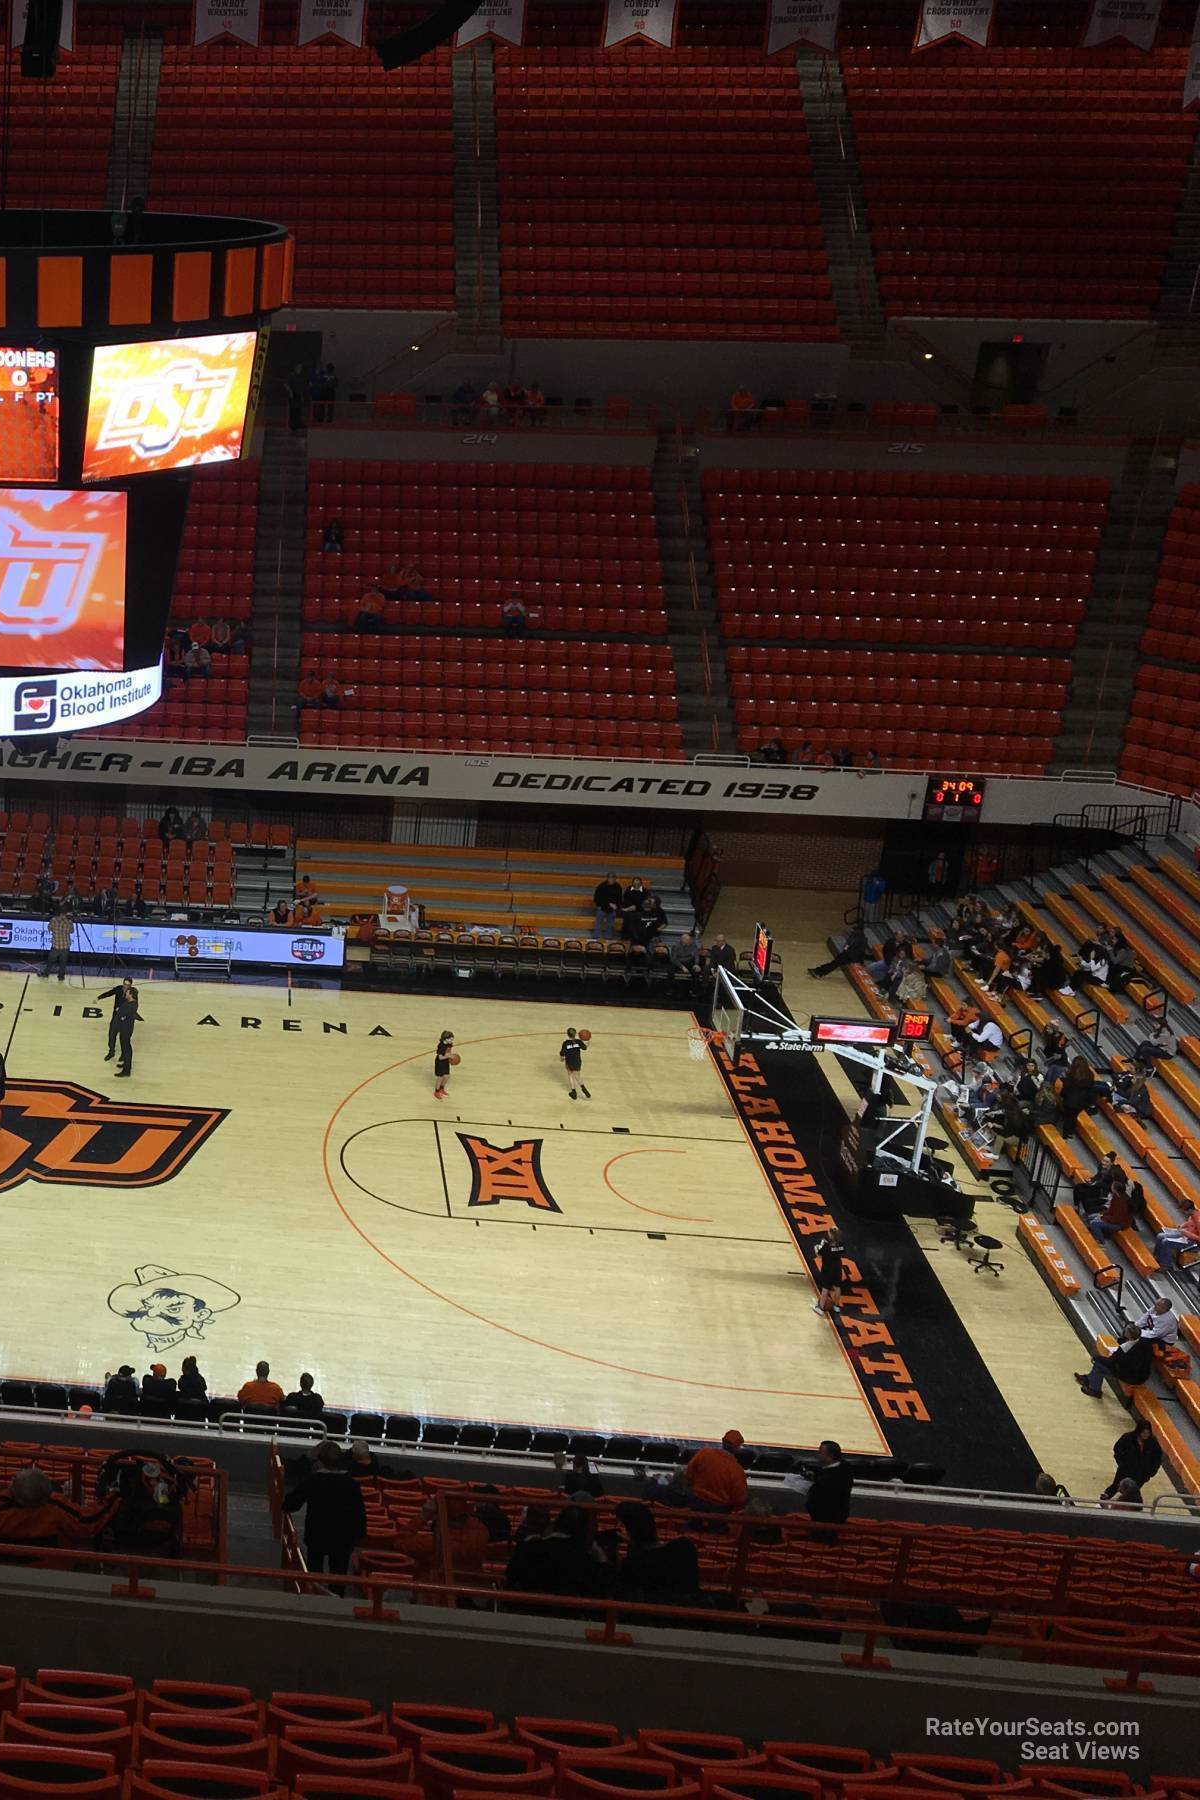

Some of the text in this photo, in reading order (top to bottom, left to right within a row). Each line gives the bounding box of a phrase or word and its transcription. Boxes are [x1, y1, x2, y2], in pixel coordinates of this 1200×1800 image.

[11, 369, 28, 386] 0
[14, 391, 24, 402] F
[36, 392, 55, 402] PT
[96, 358, 238, 459] OSU
[462, 433, 499, 444] 214
[60, 676, 133, 702] Oklahoma
[61, 682, 152, 718] Blood Institute
[267, 760, 430, 786] ARENA
[492, 771, 820, 801] DEDICATED 1938
[936, 791, 945, 802] 0
[973, 793, 982, 804] 0
[292, 942, 324, 952] BEDLAM
[196, 1014, 393, 1038] ARENA
